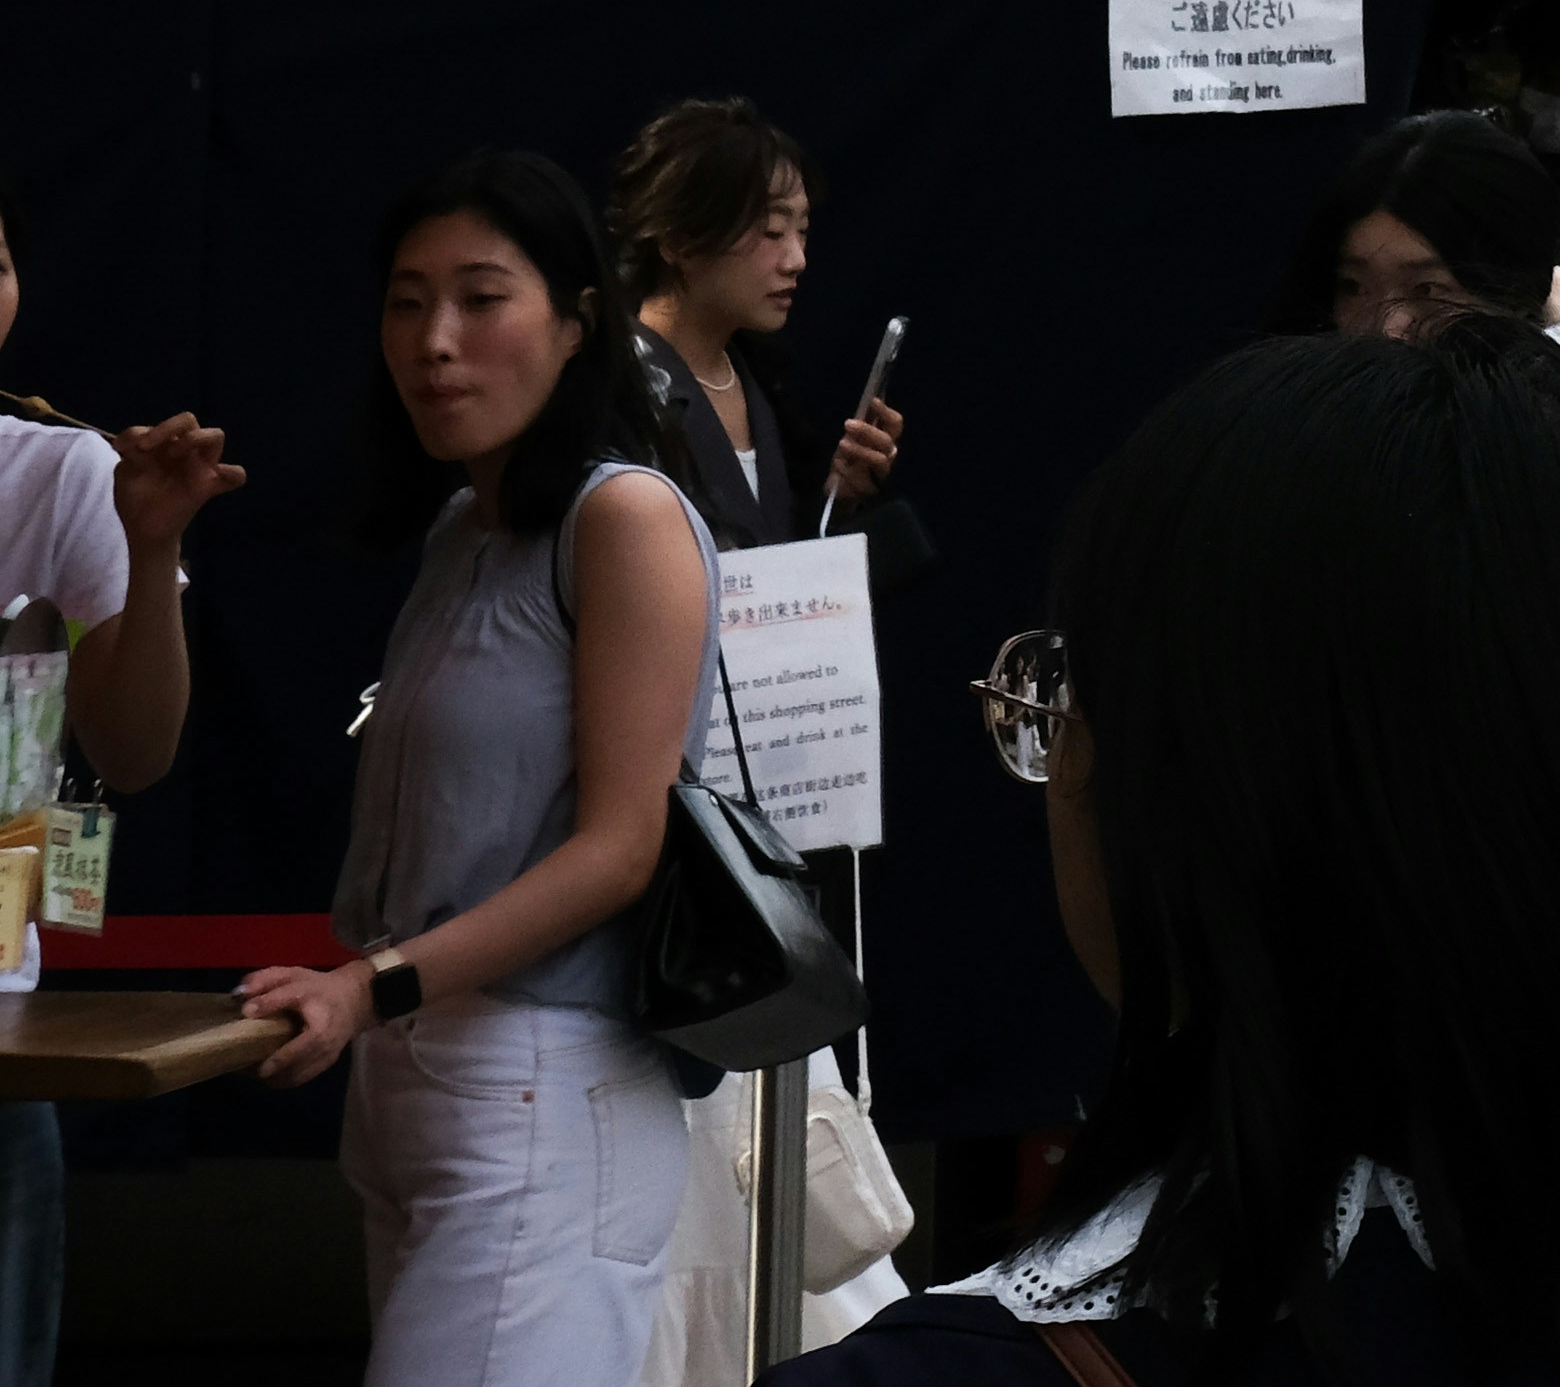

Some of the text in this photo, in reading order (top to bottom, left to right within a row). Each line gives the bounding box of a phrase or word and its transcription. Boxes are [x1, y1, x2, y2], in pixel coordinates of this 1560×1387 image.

[1122, 50, 1161, 70] Please
[1215, 48, 1243, 67] from
[1172, 86, 1193, 103] and
[1200, 81, 1250, 103] standing
[721, 574, 754, 593] 世は
[752, 677, 773, 689] not
[776, 665, 823, 685] allowed
[825, 666, 839, 677] to
[743, 708, 766, 723] this
[770, 699, 826, 719] shopping
[769, 735, 790, 748] and
[796, 728, 826, 744] drink
[833, 728, 844, 739] at
[850, 723, 869, 735] the
